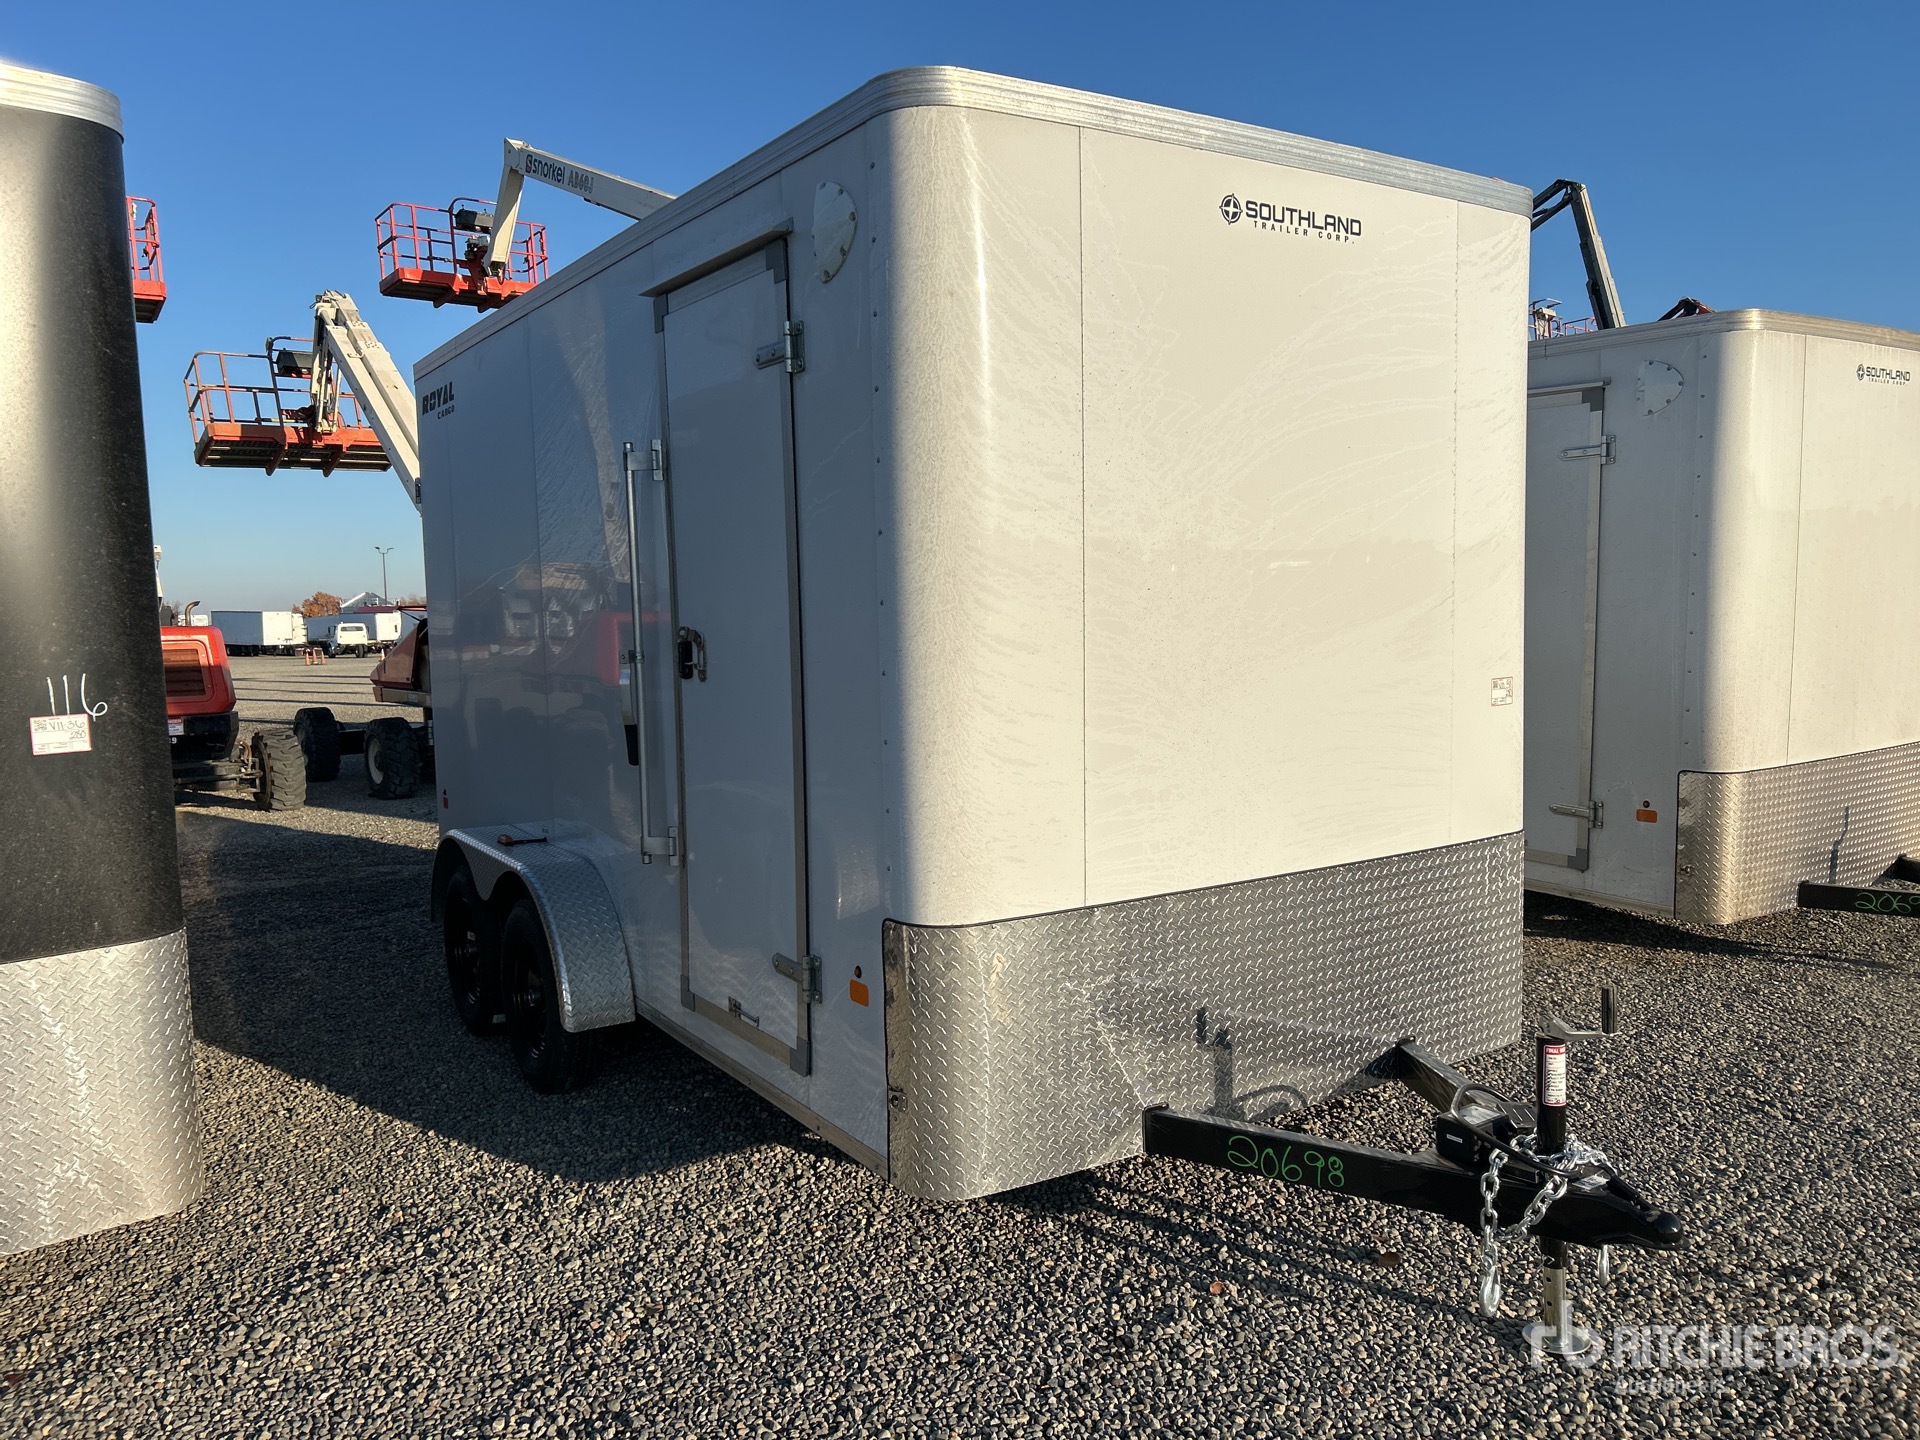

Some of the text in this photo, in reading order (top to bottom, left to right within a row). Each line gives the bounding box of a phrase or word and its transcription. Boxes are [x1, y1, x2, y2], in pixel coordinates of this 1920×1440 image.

[533, 158, 565, 185] snorkel
[1245, 200, 1361, 236] SOUTHLAND
[1254, 220, 1355, 244] TRAILER CORP.
[1866, 366, 1910, 381] SOUTHLAND
[422, 381, 454, 416] ROYAL
[437, 405, 455, 420] CARGO
[46, 673, 108, 722] 116
[1227, 1135, 1345, 1188] 20698
